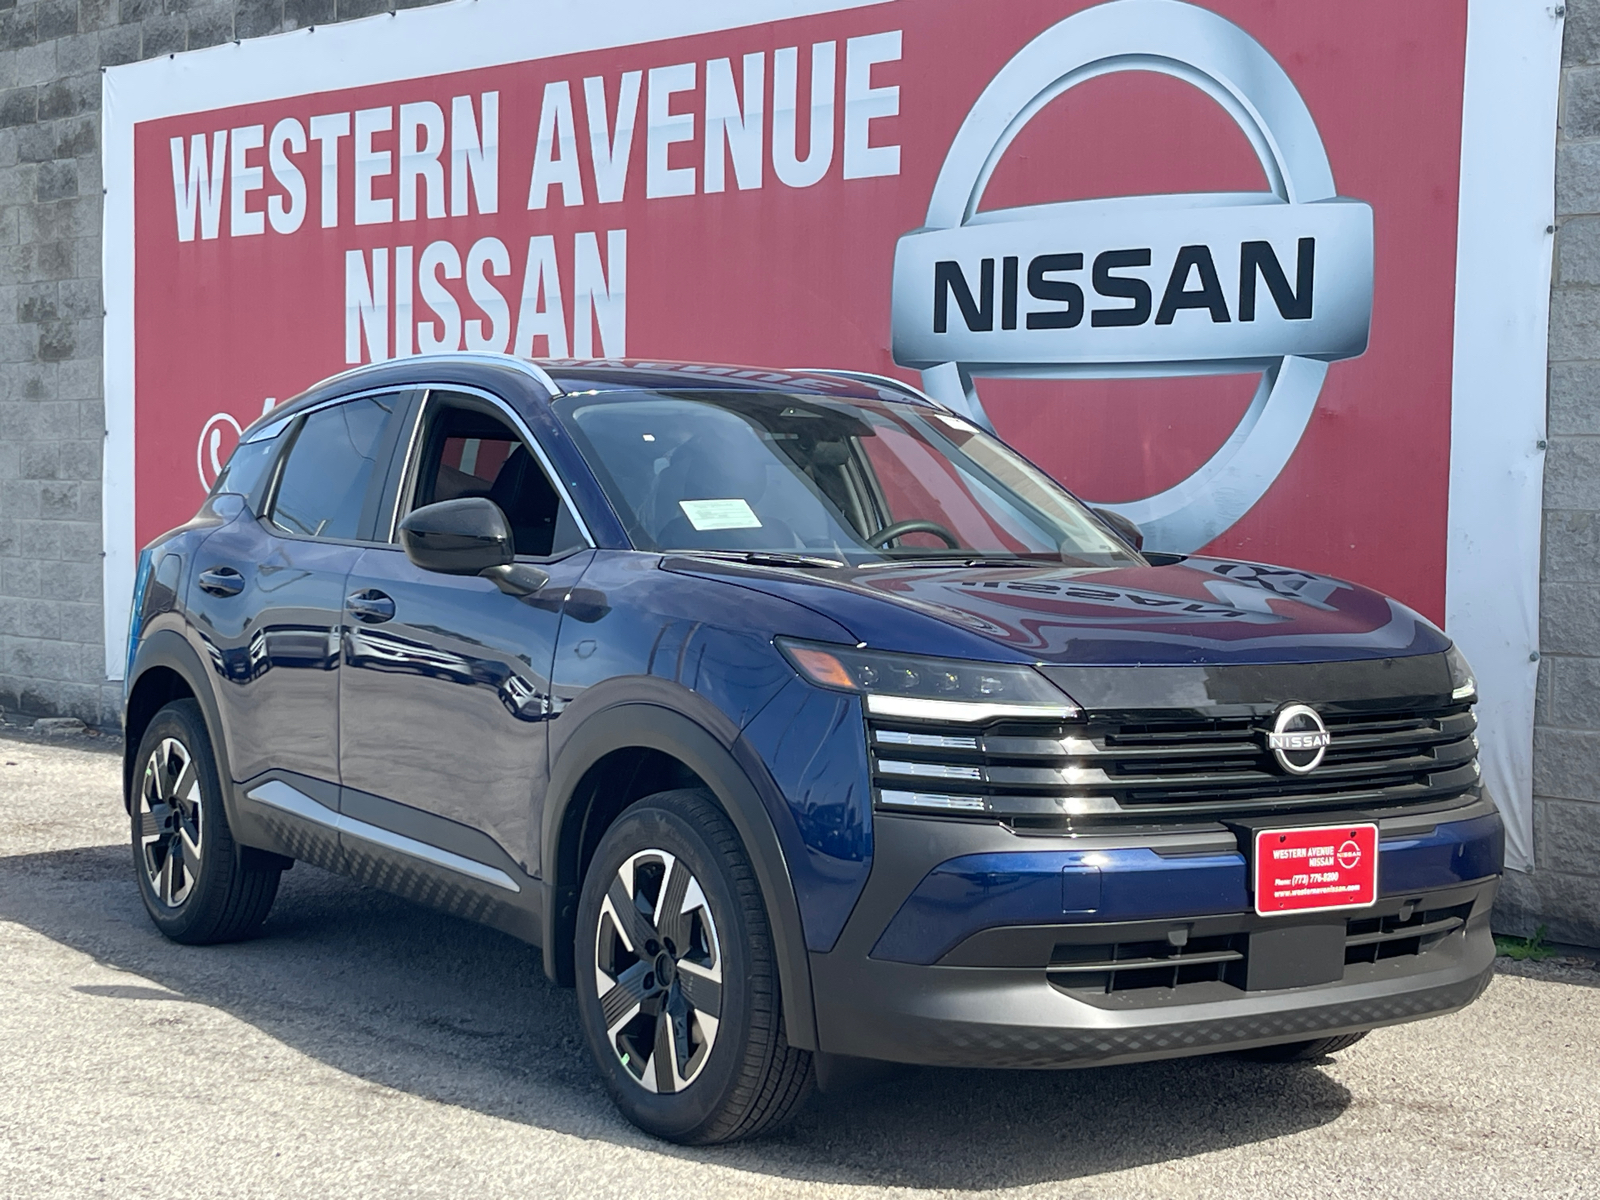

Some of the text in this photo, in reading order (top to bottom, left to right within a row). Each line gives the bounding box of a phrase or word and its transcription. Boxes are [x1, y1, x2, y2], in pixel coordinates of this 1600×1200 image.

[170, 30, 902, 242] WESTERN AVENUE
[934, 237, 1315, 333] NISSAN
[345, 230, 627, 363] NISSAN
[1270, 733, 1330, 748] NISSAN
[1272, 845, 1335, 859] WESTERN AVENUE
[1309, 856, 1335, 867] NISSAN
[1291, 874, 1309, 887] (773)
